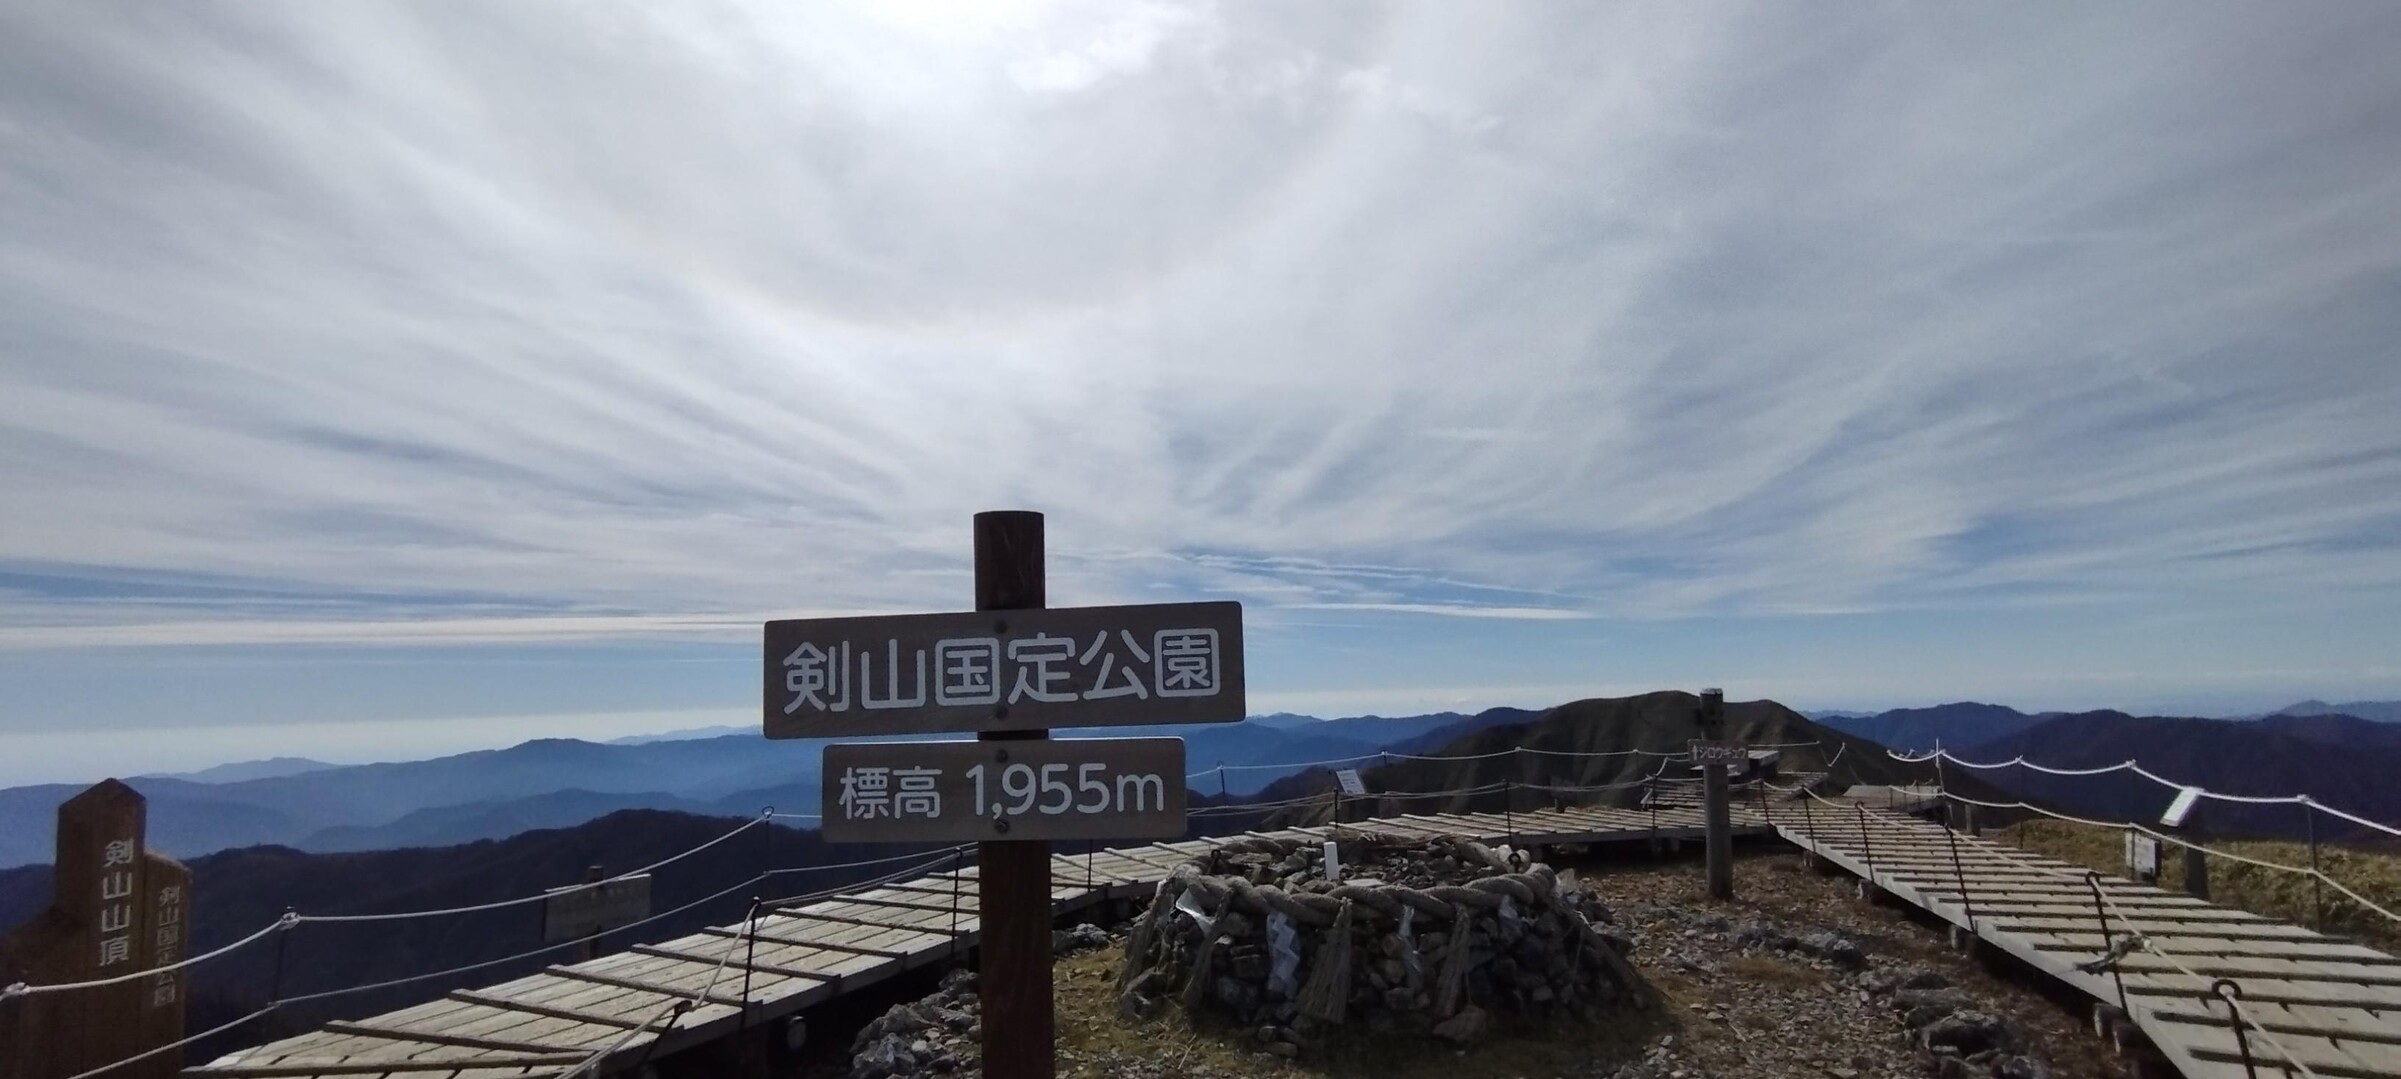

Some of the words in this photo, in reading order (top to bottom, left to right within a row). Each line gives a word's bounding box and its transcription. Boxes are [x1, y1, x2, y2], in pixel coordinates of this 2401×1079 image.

[782, 627, 1221, 715] 剣山国定公園
[839, 764, 943, 819] 標高
[965, 761, 1165, 821] 1,955m
[99, 838, 135, 967] 剣山山頂
